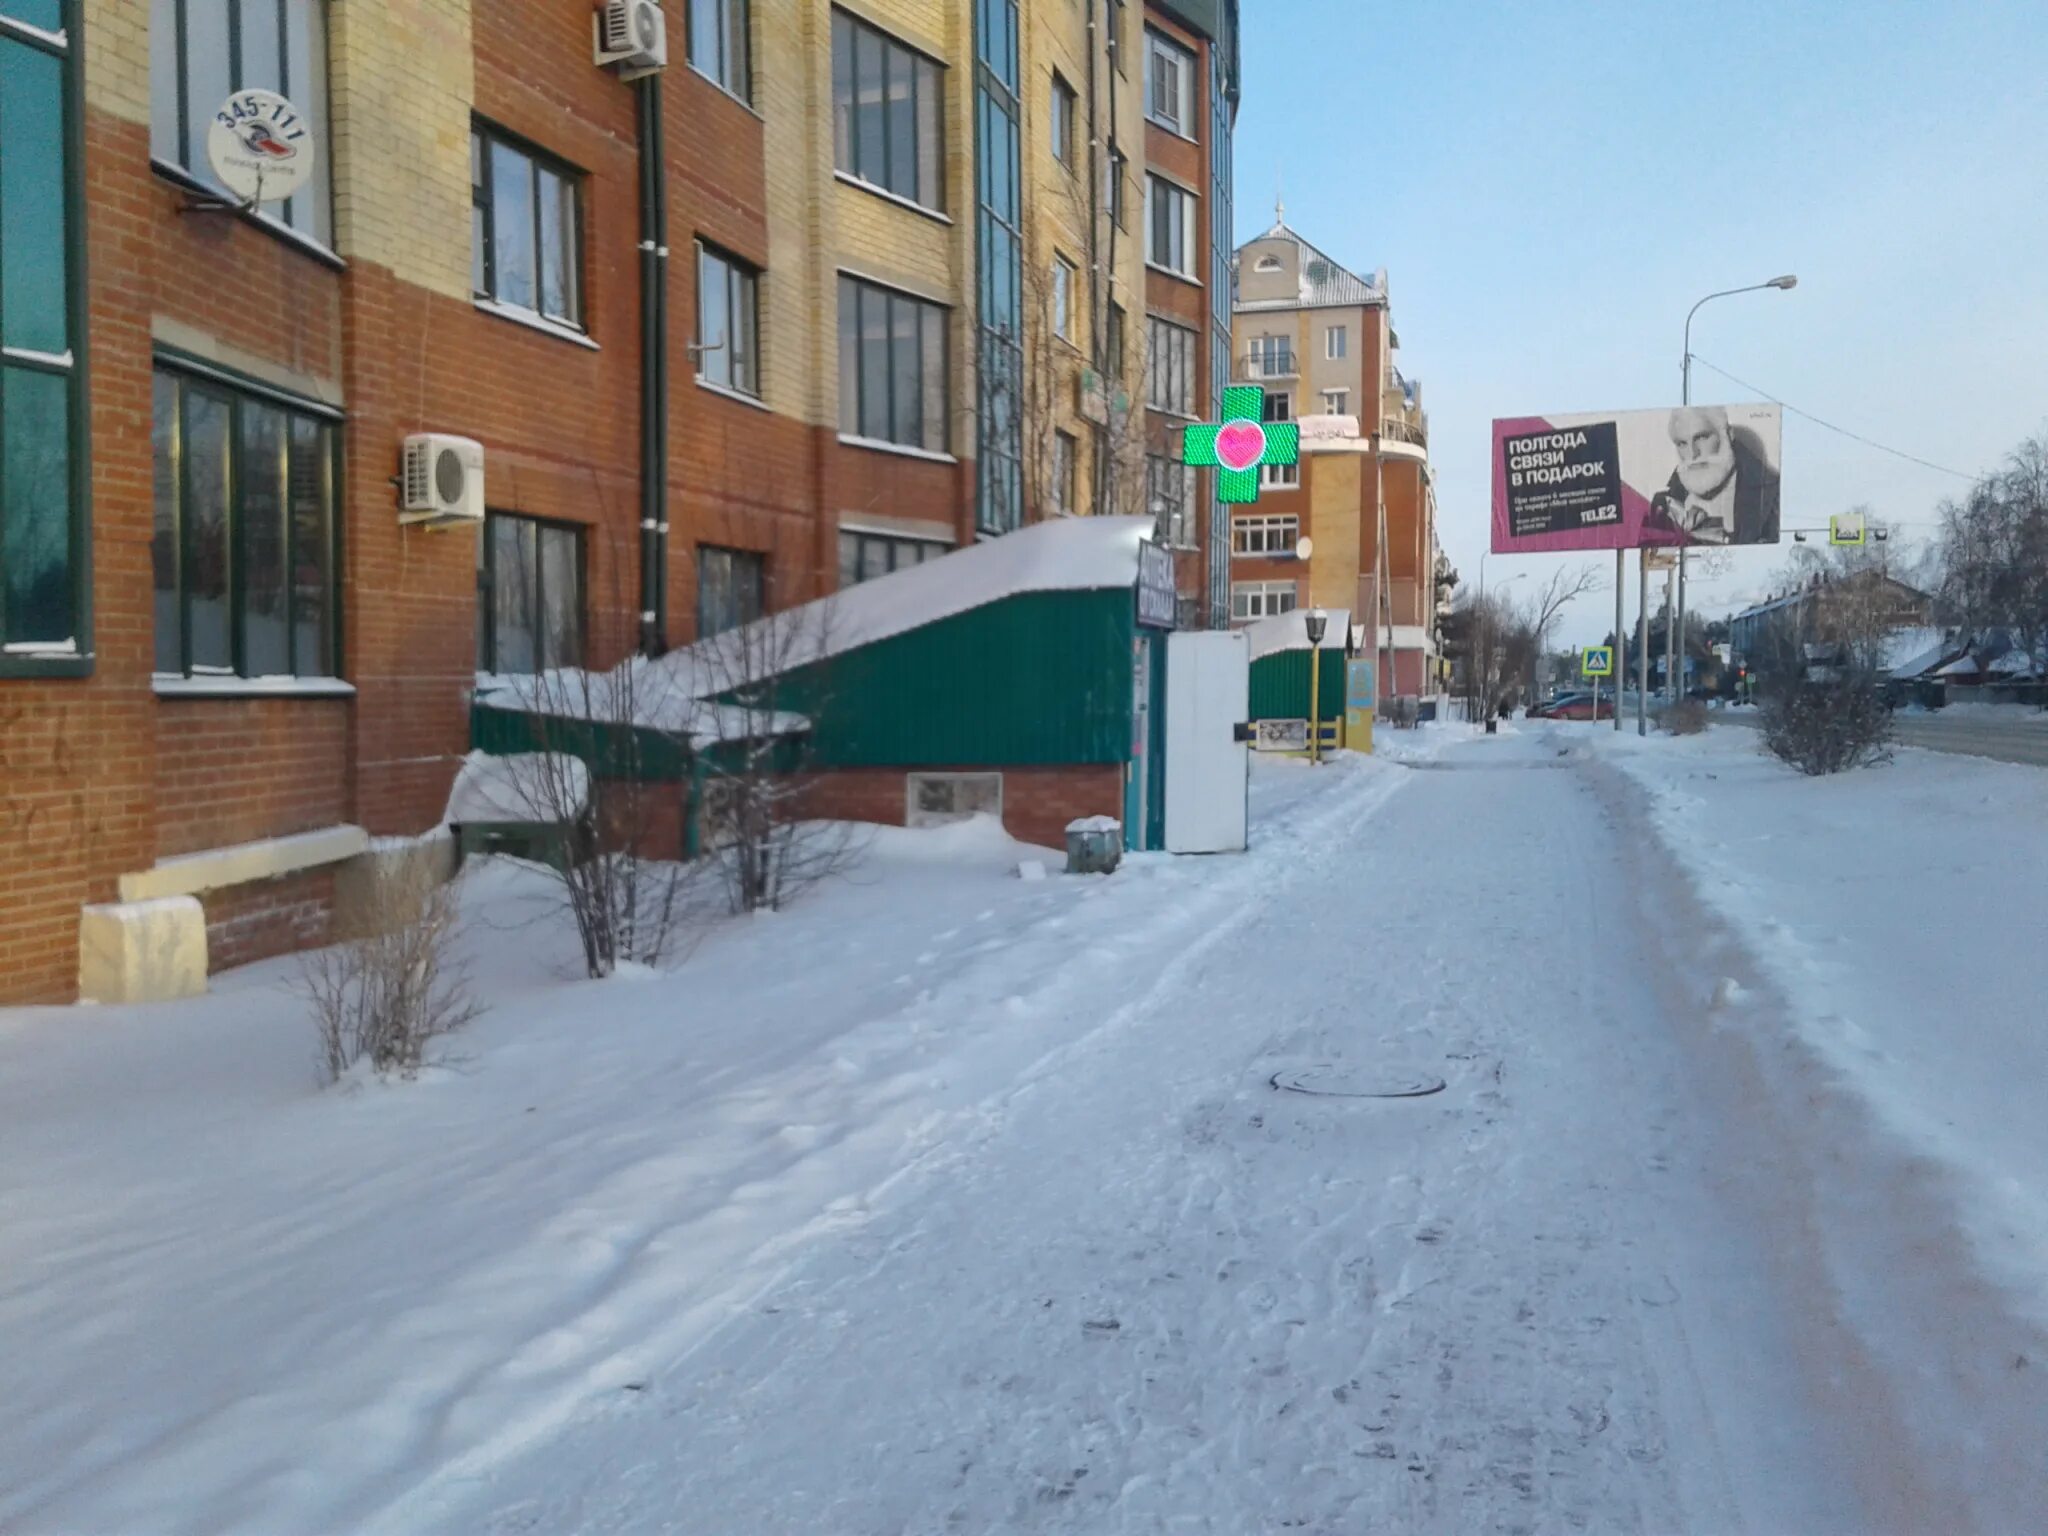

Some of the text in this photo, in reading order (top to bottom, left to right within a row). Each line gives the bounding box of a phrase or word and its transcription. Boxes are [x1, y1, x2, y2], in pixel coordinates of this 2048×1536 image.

[216, 96, 305, 140] 345-111
[1509, 431, 1587, 454] ПОЛГОДА
[1510, 450, 1565, 470] СВЯЗИ
[1511, 461, 1605, 486] В ПОДАРОК
[1580, 504, 1617, 522] TELE2
